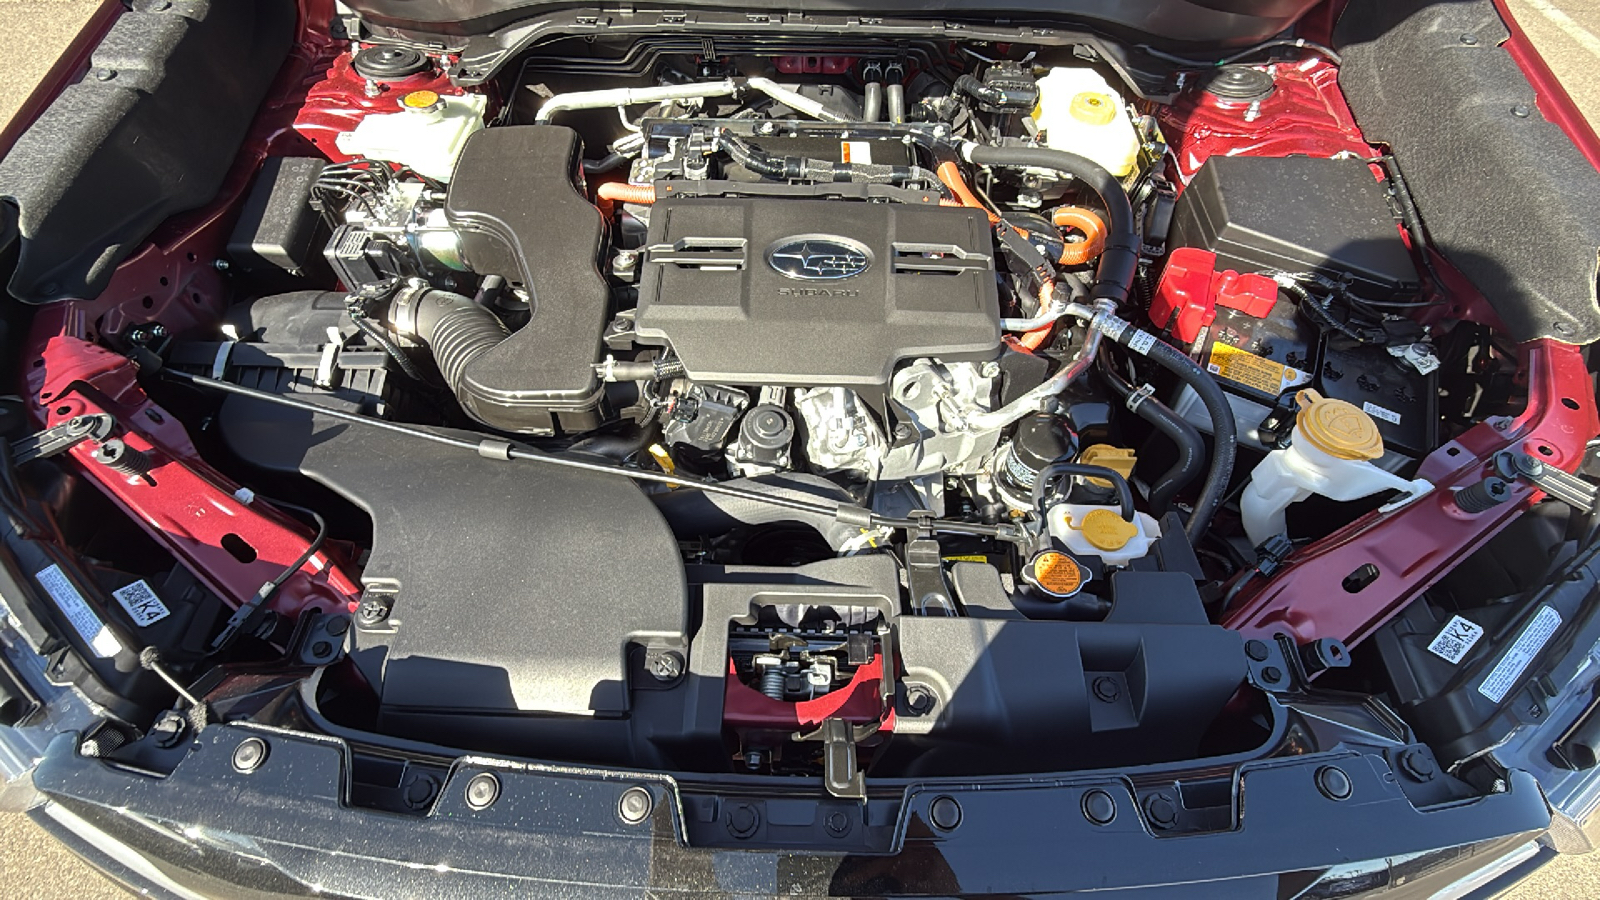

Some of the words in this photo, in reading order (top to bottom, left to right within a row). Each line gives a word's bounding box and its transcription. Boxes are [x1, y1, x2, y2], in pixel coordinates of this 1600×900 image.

[777, 287, 859, 297] SUBARU
[137, 600, 161, 620] K4
[1449, 621, 1475, 642] K4
